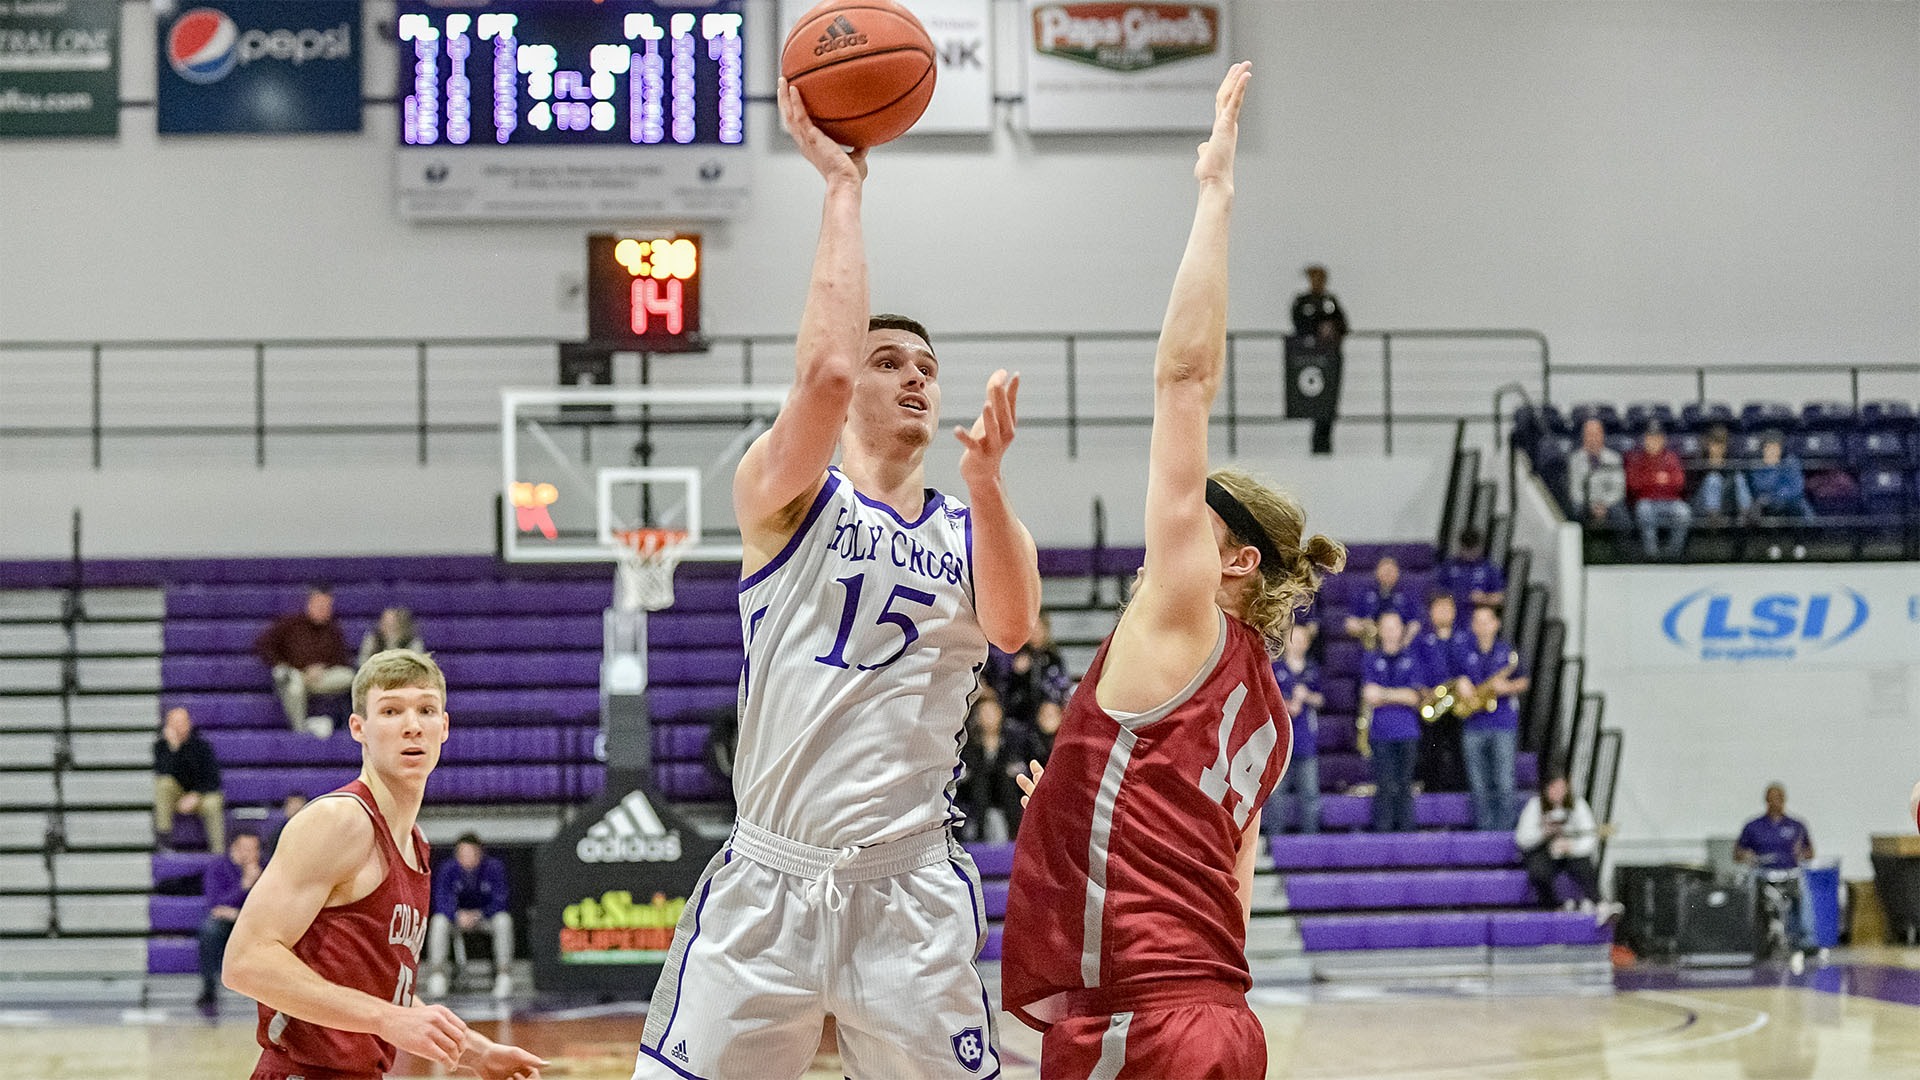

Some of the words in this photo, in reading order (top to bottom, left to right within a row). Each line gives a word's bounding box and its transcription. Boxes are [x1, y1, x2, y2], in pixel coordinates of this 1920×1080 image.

[238, 21, 351, 66] pepsi
[814, 34, 868, 57] adidas
[1042, 7, 1120, 51] Papa
[631, 278, 682, 335] 14
[826, 507, 884, 562] HOLY
[814, 573, 936, 672] 15
[1702, 593, 1831, 641] LSI
[1199, 681, 1278, 831] 14
[576, 836, 682, 863] adidas
[560, 927, 676, 952] SUPERM
[671, 1049, 689, 1064] adidas
